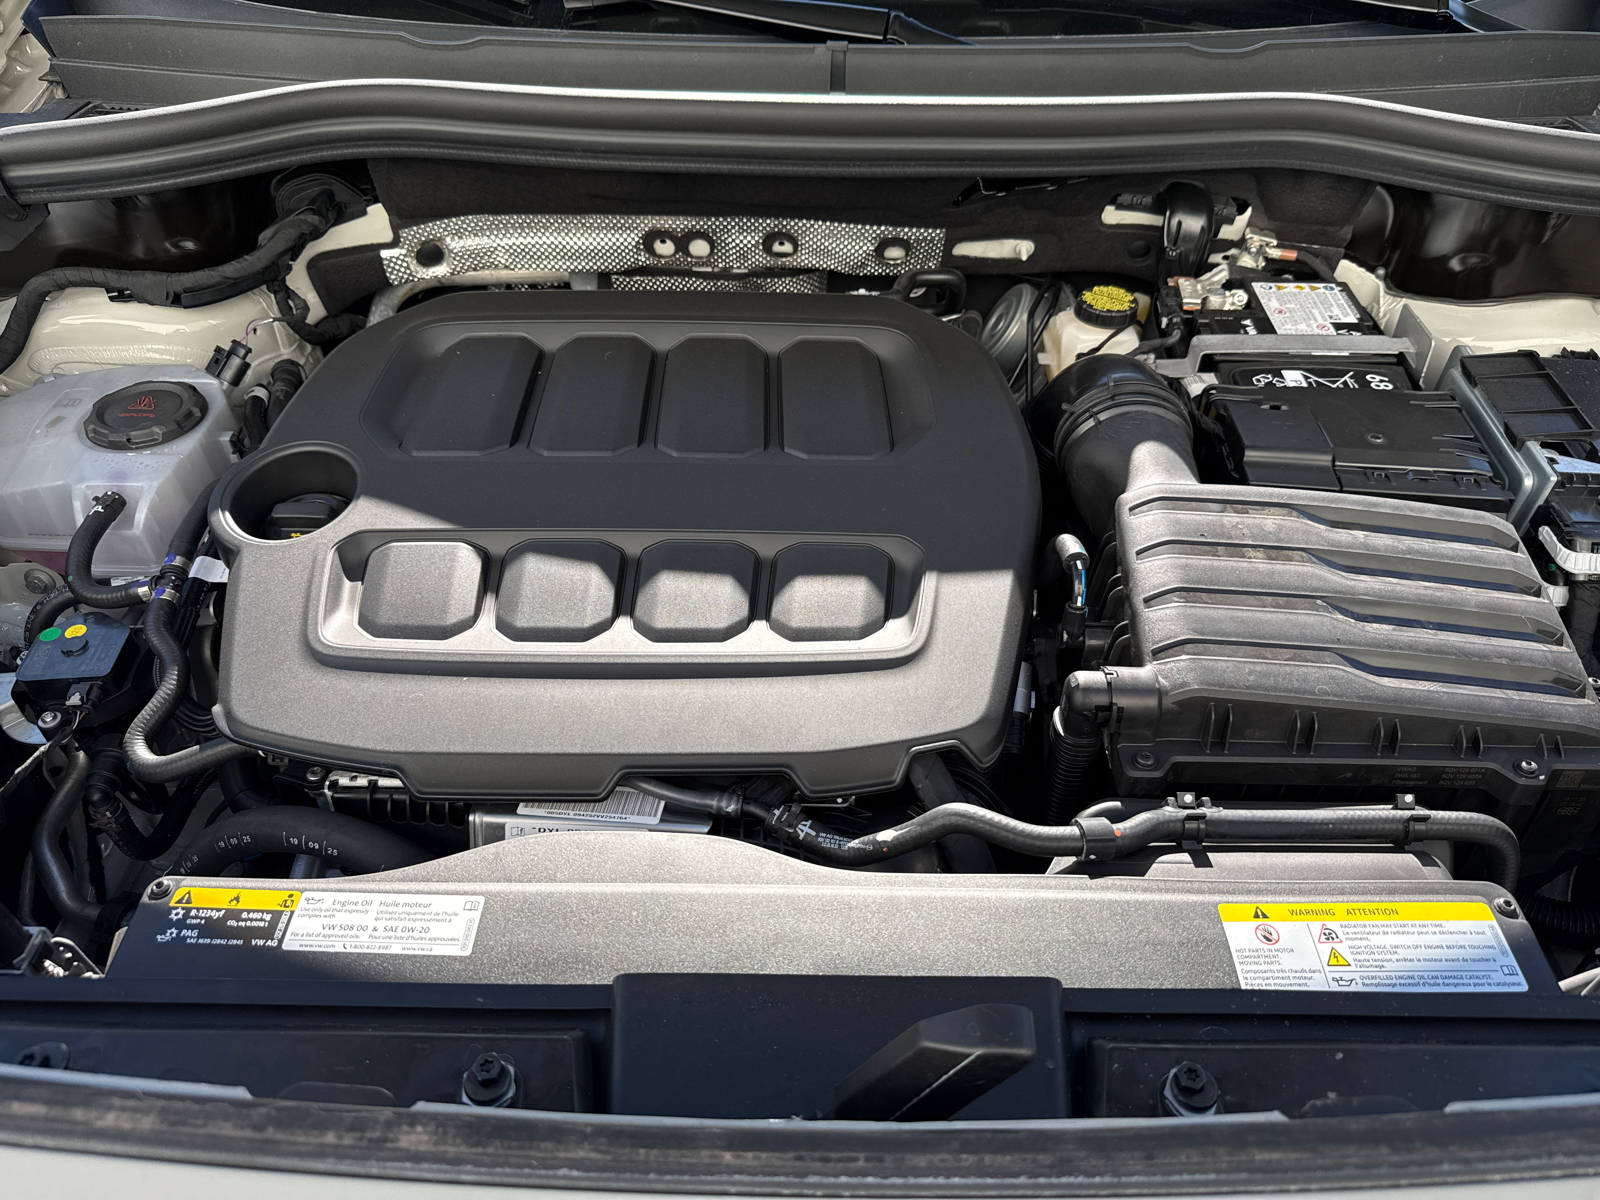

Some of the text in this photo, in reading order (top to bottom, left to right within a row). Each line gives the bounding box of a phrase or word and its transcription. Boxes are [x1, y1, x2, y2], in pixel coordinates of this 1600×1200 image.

[308, 841, 320, 849] 09
[327, 847, 338, 856] 25
[332, 899, 360, 908] Engine
[189, 909, 226, 918] R-1234yf
[262, 912, 272, 921] kg
[1288, 908, 1335, 916] WARNING
[180, 929, 199, 937] PAG
[401, 926, 430, 934] 0W-20
